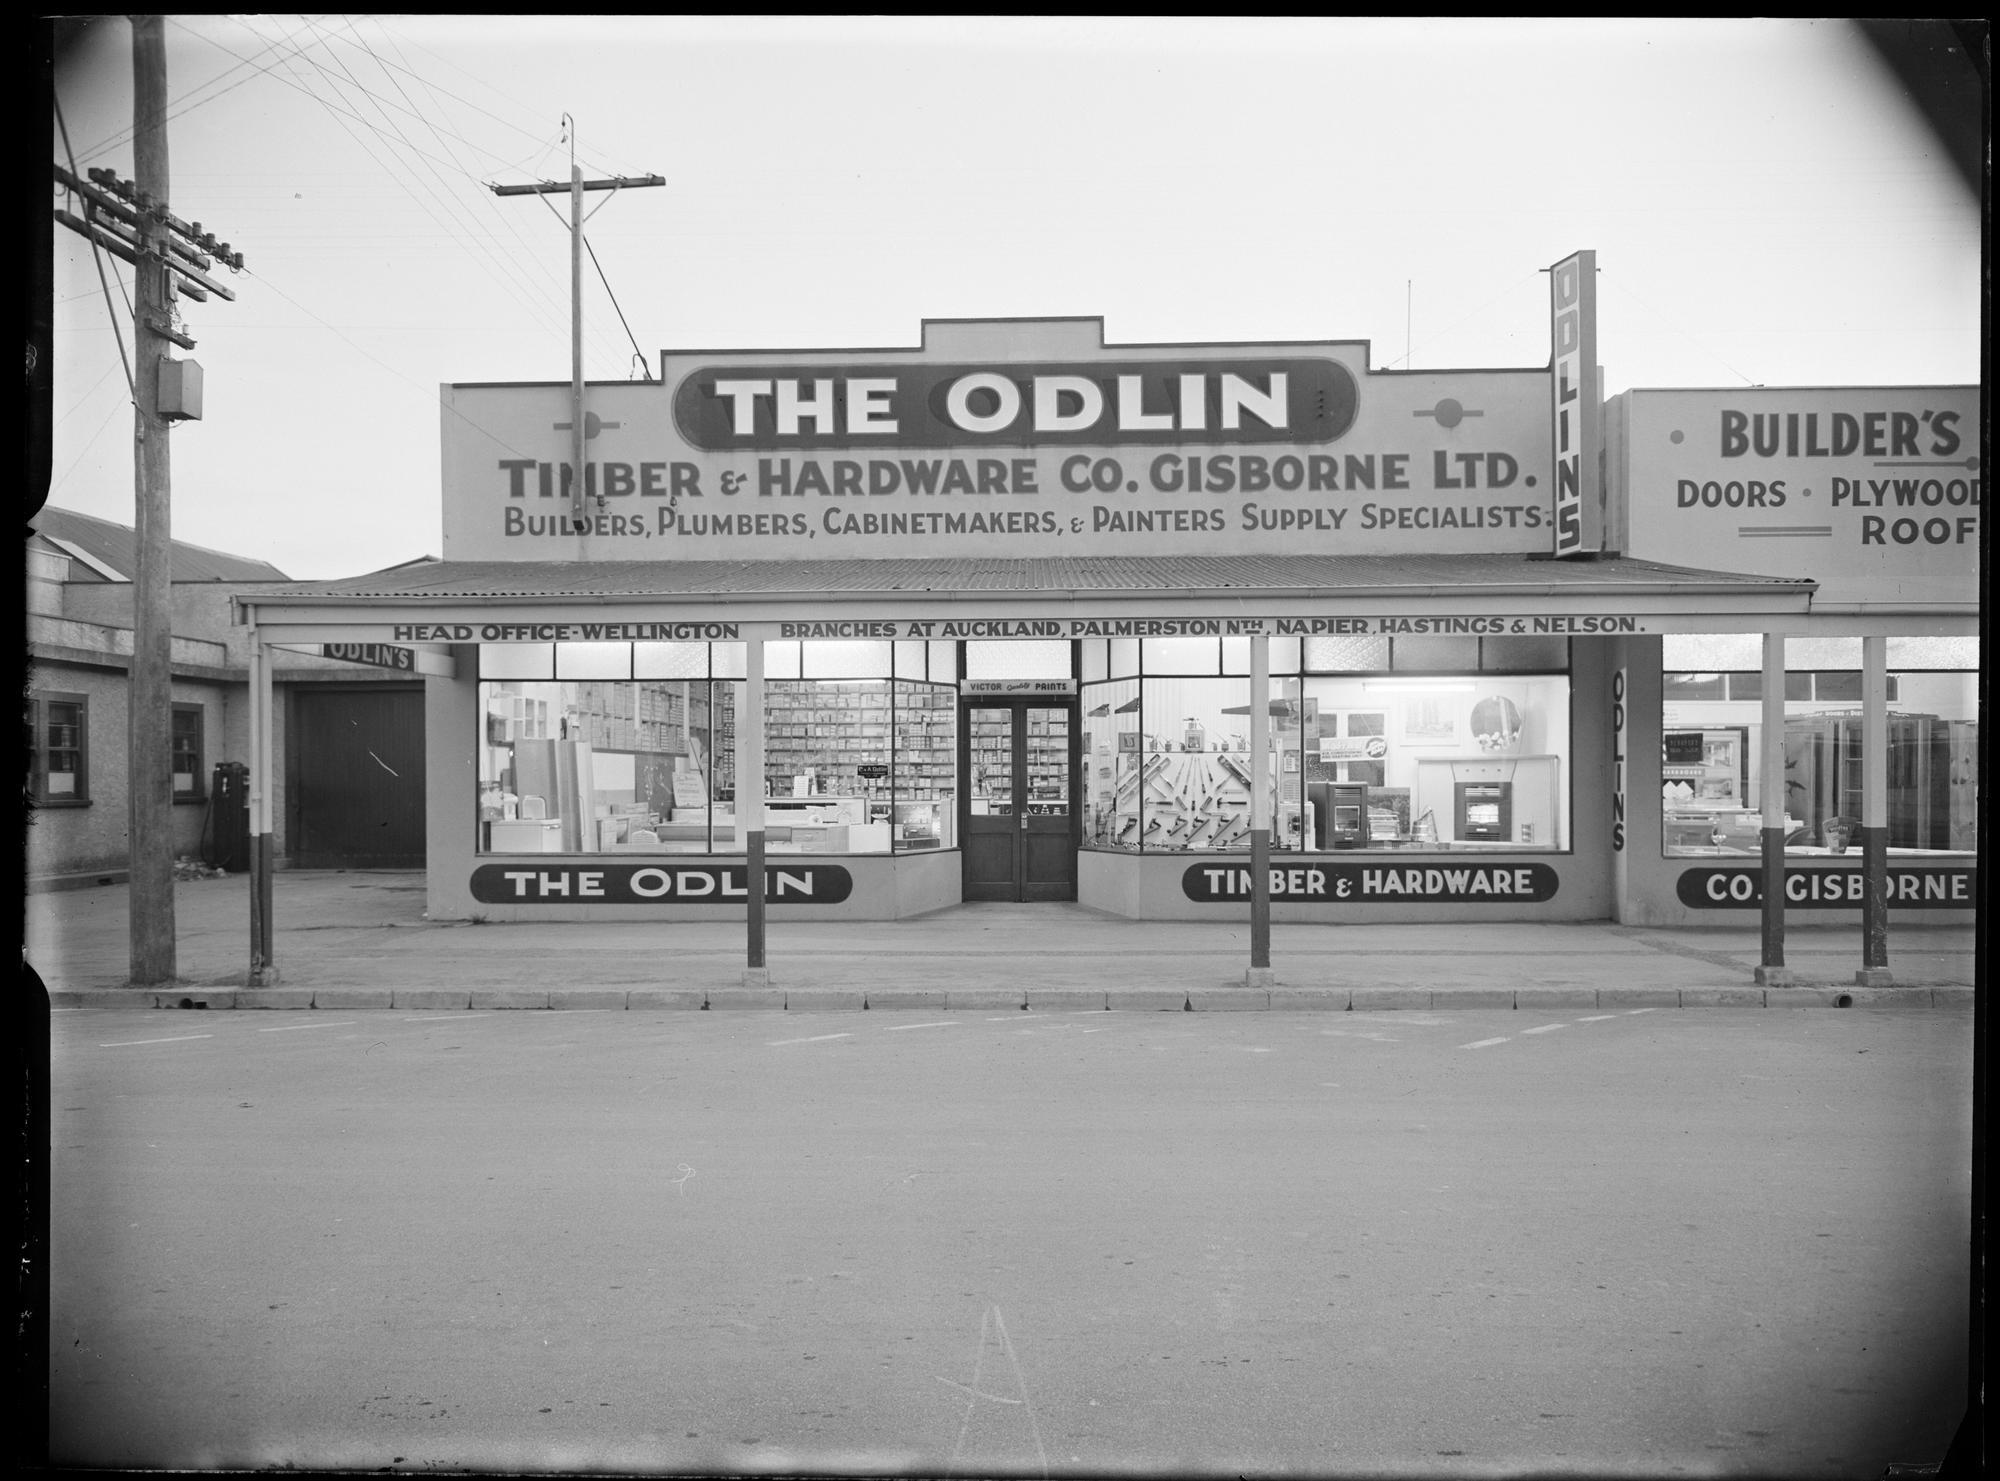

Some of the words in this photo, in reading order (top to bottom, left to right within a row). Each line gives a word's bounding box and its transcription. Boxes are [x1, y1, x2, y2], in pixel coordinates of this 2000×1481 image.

[715, 379, 898, 434] THE
[945, 371, 1289, 434] ODLIN
[1556, 261, 1580, 551] ODLINS
[1721, 410, 1961, 457] BUILDER'S
[499, 459, 704, 498] TIMBER
[720, 470, 748, 494] &
[757, 458, 1039, 496] HARDWARE
[1060, 454, 1139, 493] CO.
[1149, 453, 1410, 492] GISBORNE
[1433, 450, 1537, 488] LTD.
[1677, 480, 1787, 508] DOORS
[505, 506, 651, 538] BUILDERS,
[658, 506, 815, 538] PLUMBERS,
[822, 507, 1064, 535] CABINETMAKERS,
[1071, 517, 1085, 534] &
[1093, 506, 1226, 532] PAINTERS
[1242, 503, 1348, 530] SUPPLY
[1361, 503, 1553, 528] SPECIALISTS.
[1862, 515, 1977, 545] ROOF
[394, 625, 473, 641] HEAD
[781, 622, 897, 638] BRANCHES
[907, 622, 936, 637] AT
[942, 621, 1066, 638] AUCKLAND,
[1071, 620, 1221, 636] PALMERSTON
[1380, 617, 1504, 634] HASTINGS
[1510, 619, 1526, 633] &
[1533, 616, 1646, 633] NELSON.
[331, 644, 408, 669] ODLIN'S
[970, 683, 1002, 691] VICTOR
[1613, 671, 1624, 851] ODLINS
[504, 872, 605, 896] THE
[1336, 878, 1353, 898] &
[1362, 869, 1534, 894] HARDWARE
[1706, 874, 1763, 900] CO.
